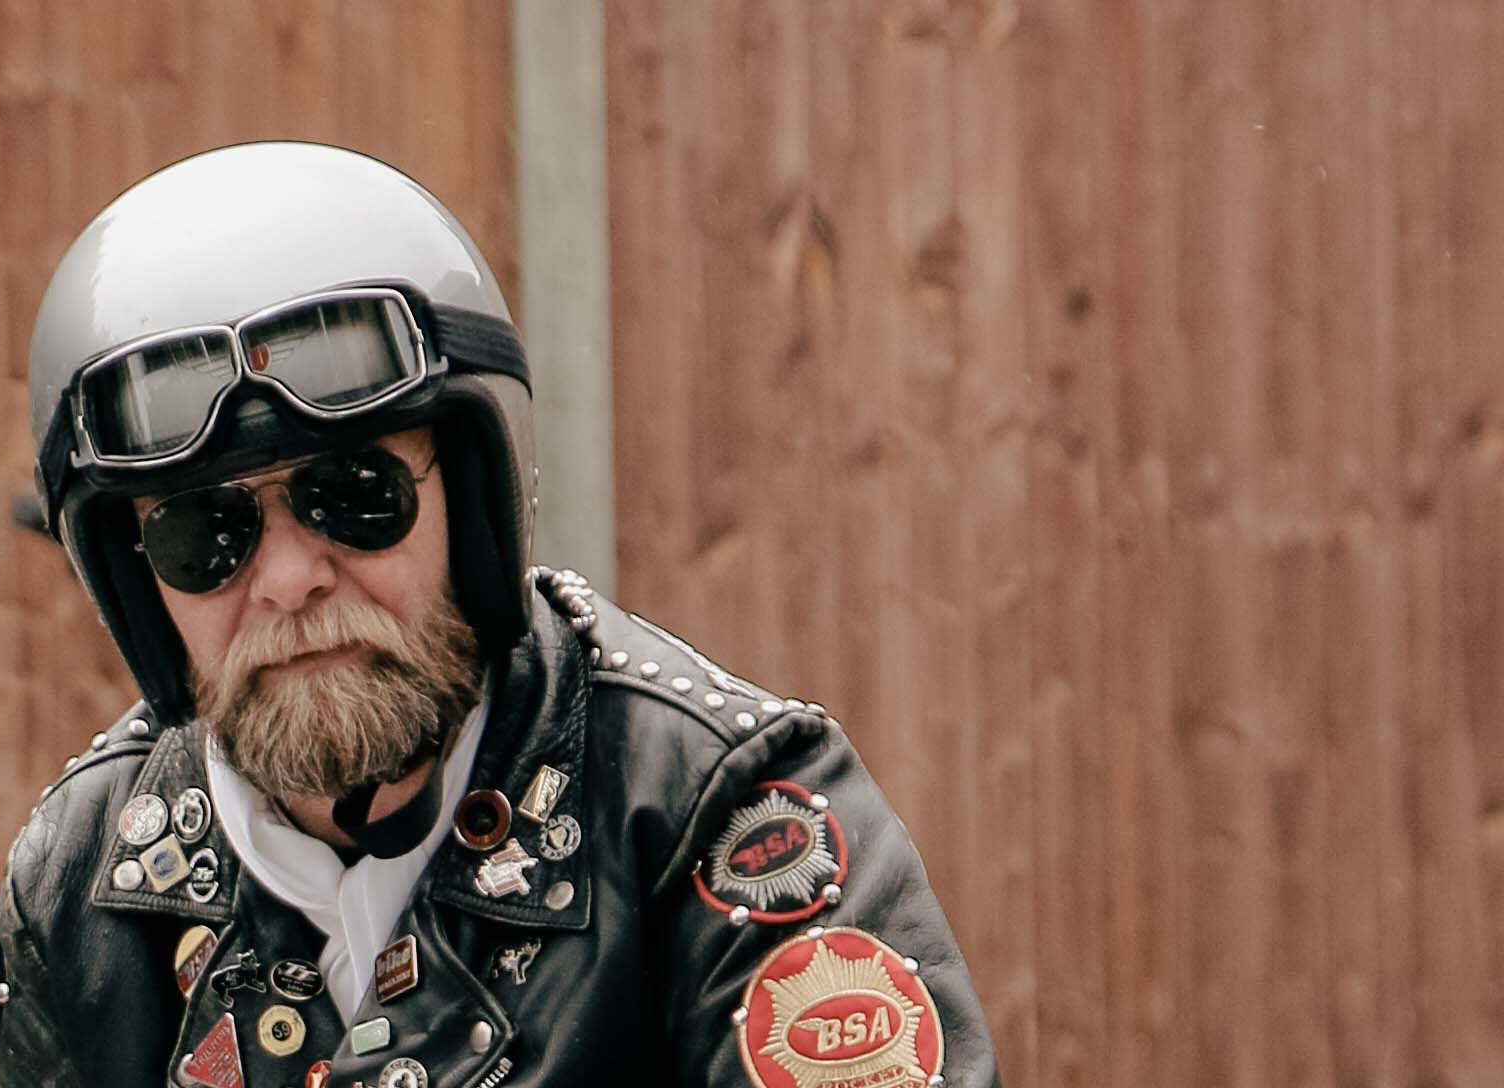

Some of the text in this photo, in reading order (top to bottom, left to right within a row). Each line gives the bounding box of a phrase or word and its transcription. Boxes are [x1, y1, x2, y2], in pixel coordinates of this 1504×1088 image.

[745, 820, 807, 873] BSA
[273, 1022, 291, 1039] 59
[817, 1005, 893, 1053] BSA
